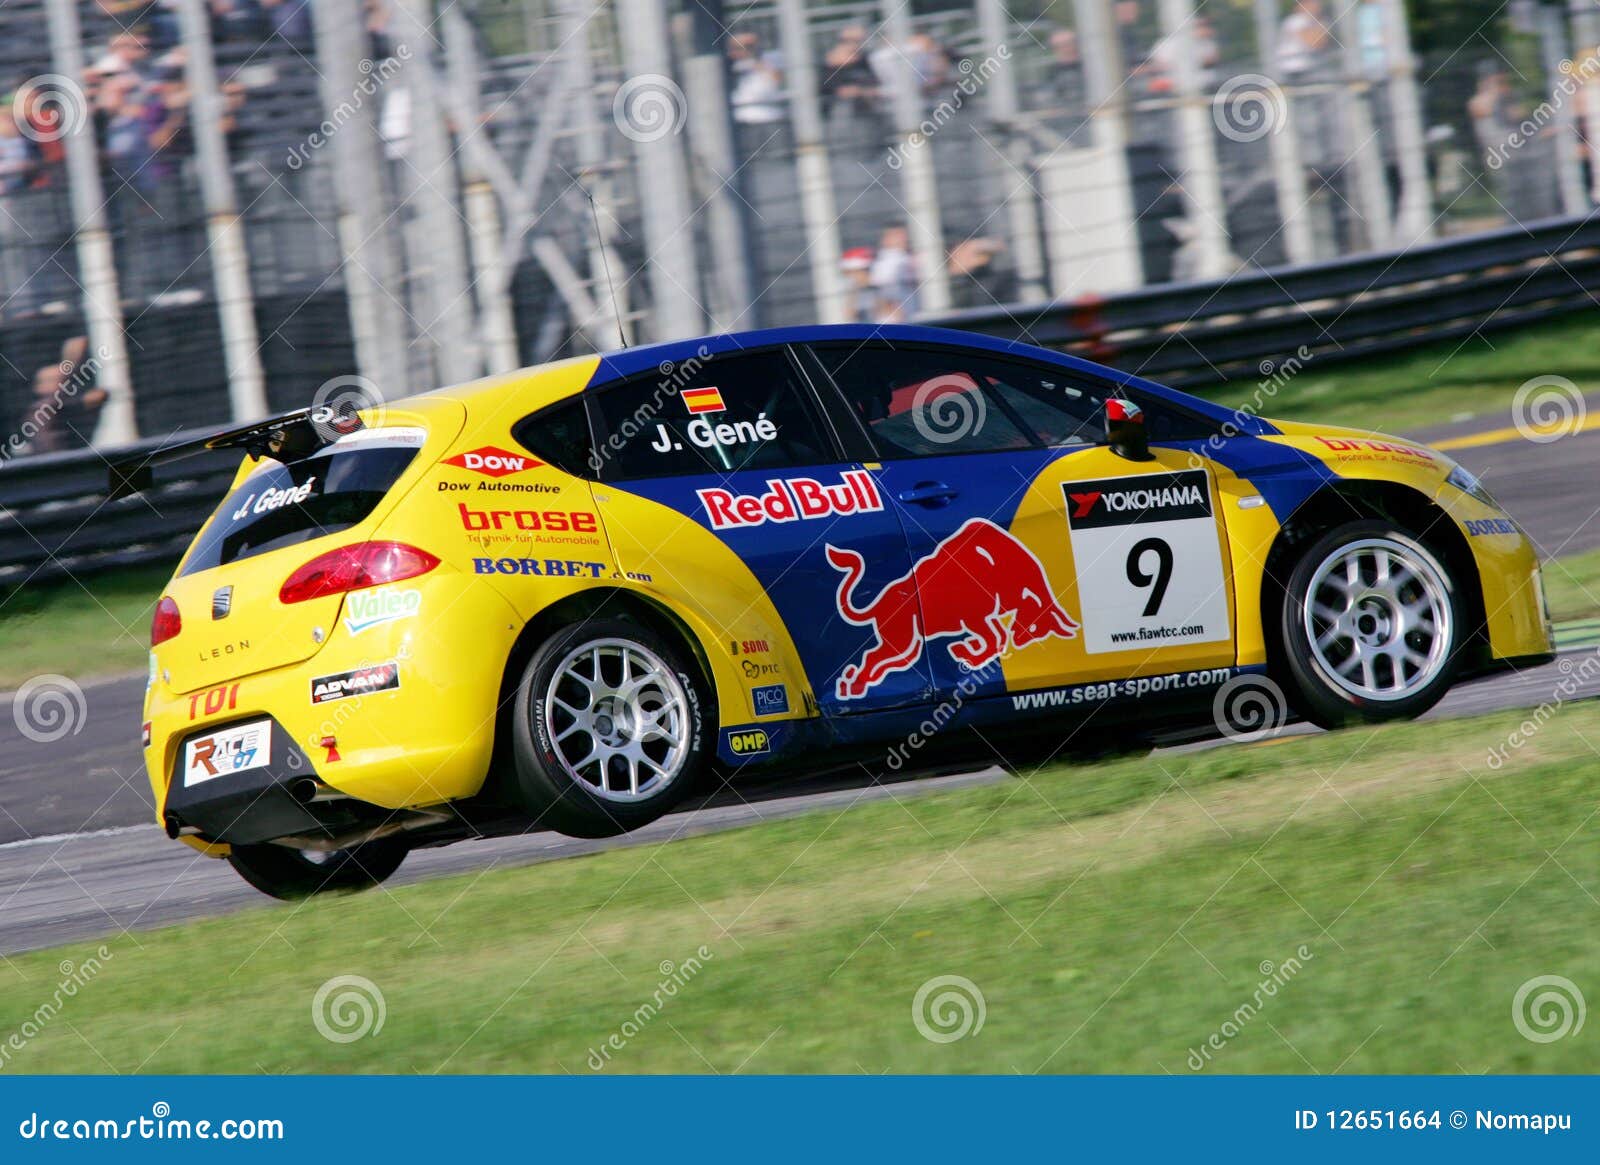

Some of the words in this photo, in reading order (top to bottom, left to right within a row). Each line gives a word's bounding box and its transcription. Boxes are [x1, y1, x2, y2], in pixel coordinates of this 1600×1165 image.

[652, 424, 683, 453] J.
[687, 412, 778, 448] Gené
[463, 453, 525, 471] DOW
[253, 477, 317, 515] Gené
[438, 481, 470, 492] Dow
[477, 480, 561, 494] Automotive
[699, 480, 797, 528] Red
[789, 471, 883, 519] Bull
[1101, 485, 1204, 512] YOKOHAMA
[458, 503, 597, 533] brose
[535, 534, 600, 546] Automobile
[1126, 537, 1174, 617] 9
[350, 589, 419, 618] Valeo
[1111, 624, 1204, 643] www.fiawtcc.com
[199, 639, 251, 662] LEON
[314, 672, 385, 696] ADVAN
[1012, 667, 1231, 711] www.seat-sport.com
[188, 683, 240, 720] TDI
[731, 733, 766, 752] OMP
